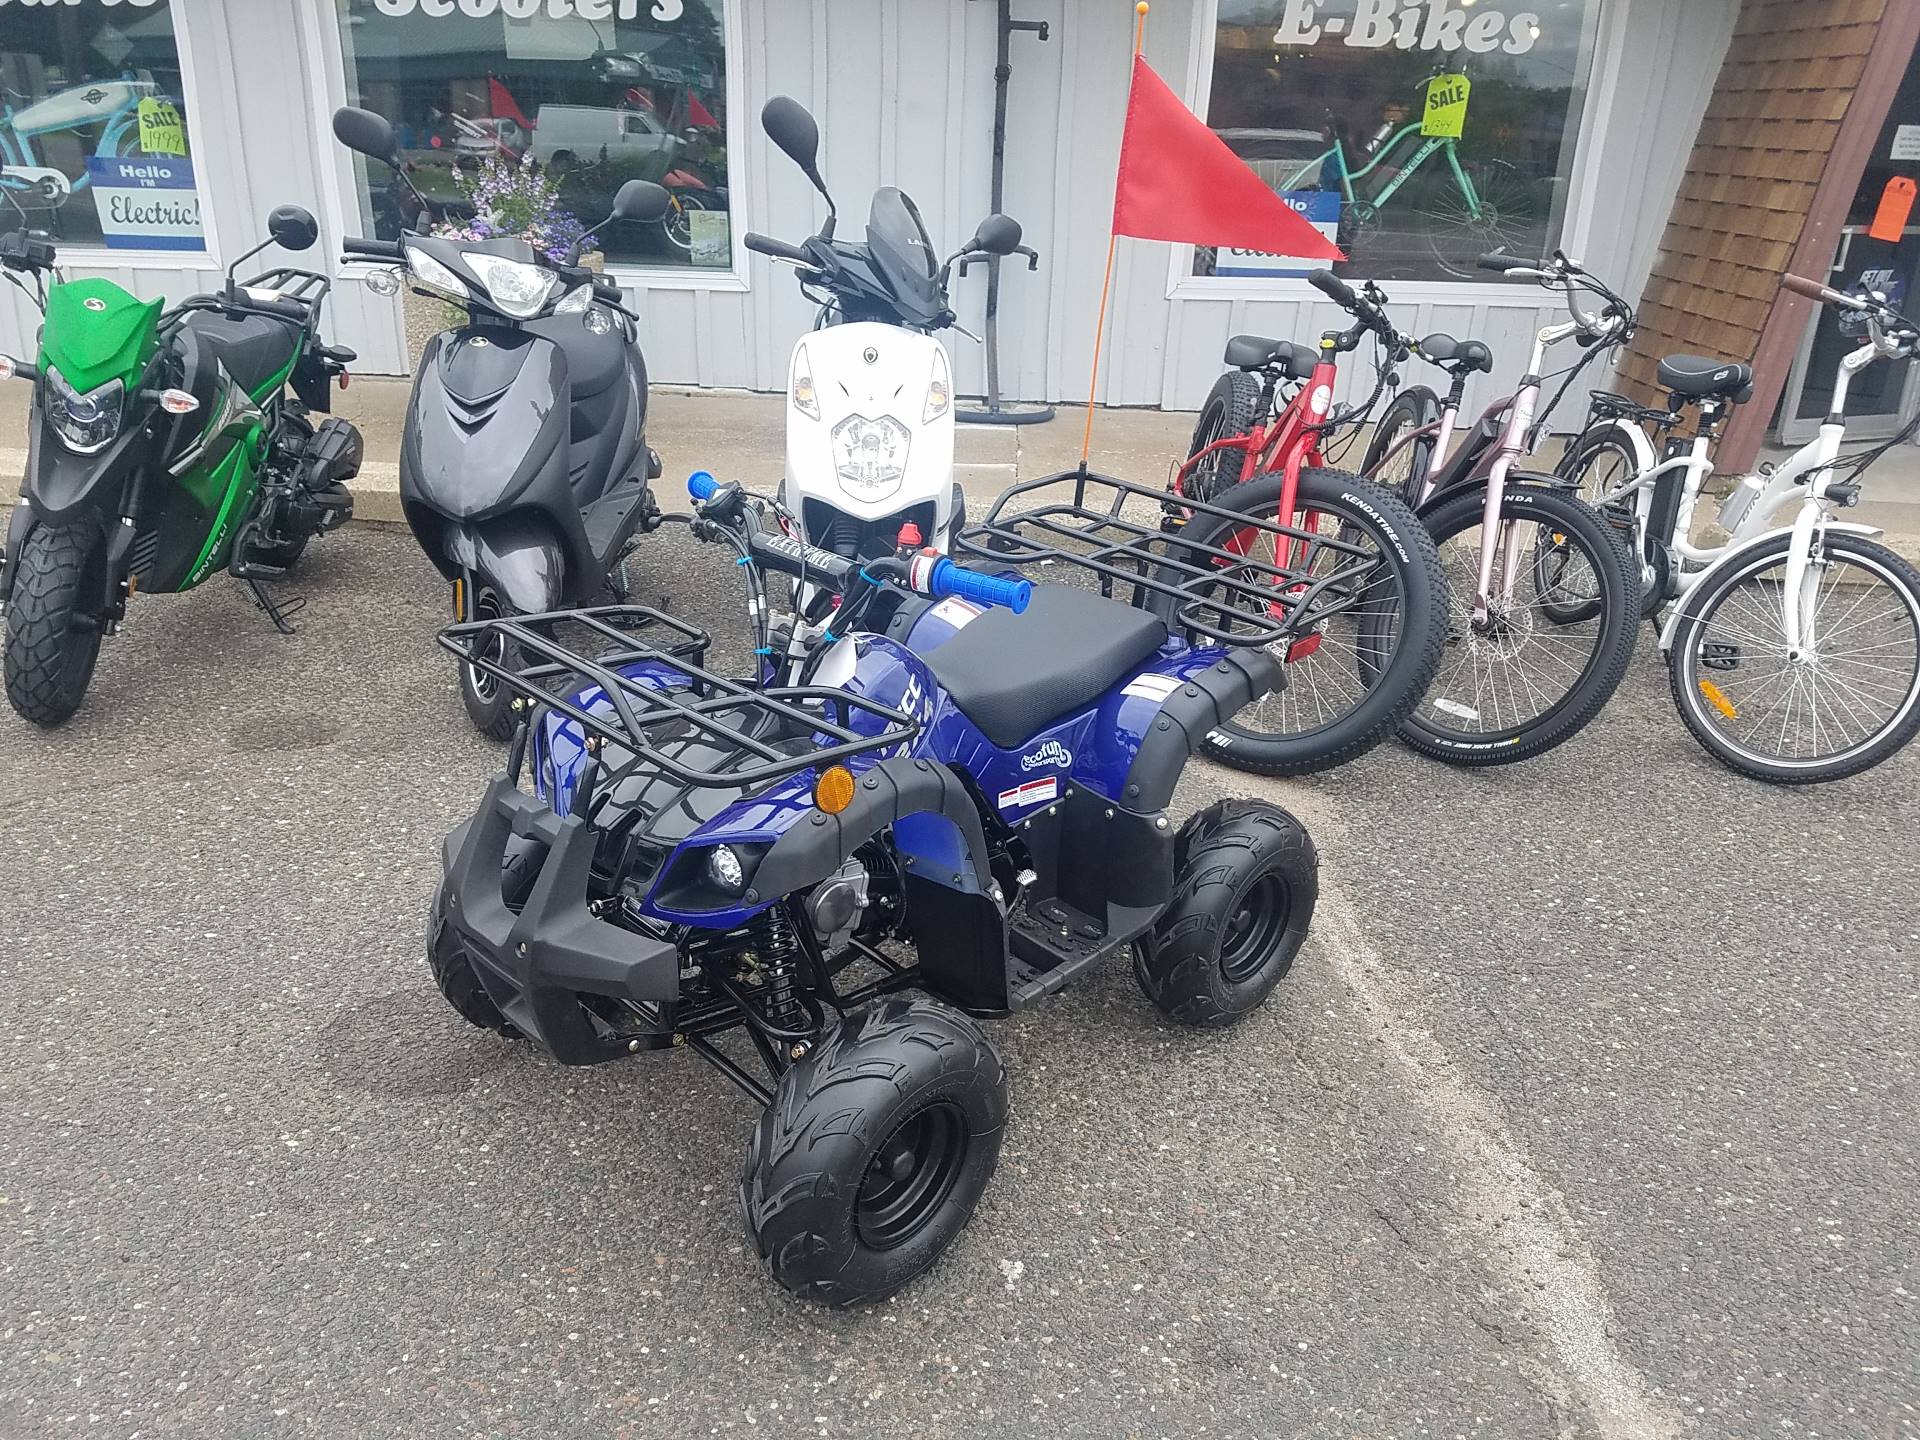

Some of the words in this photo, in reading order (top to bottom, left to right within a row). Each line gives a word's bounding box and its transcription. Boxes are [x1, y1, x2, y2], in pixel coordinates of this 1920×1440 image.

[1273, 0, 1540, 54] E-Bikes
[1429, 85, 1465, 110] SALE
[142, 112, 179, 129] SALE
[119, 164, 172, 179] Hello
[110, 195, 200, 225] Electric!
[1283, 198, 1308, 212] llo
[1340, 492, 1410, 563] KENDATIRE.COM
[192, 523, 227, 582] BINTELLI
